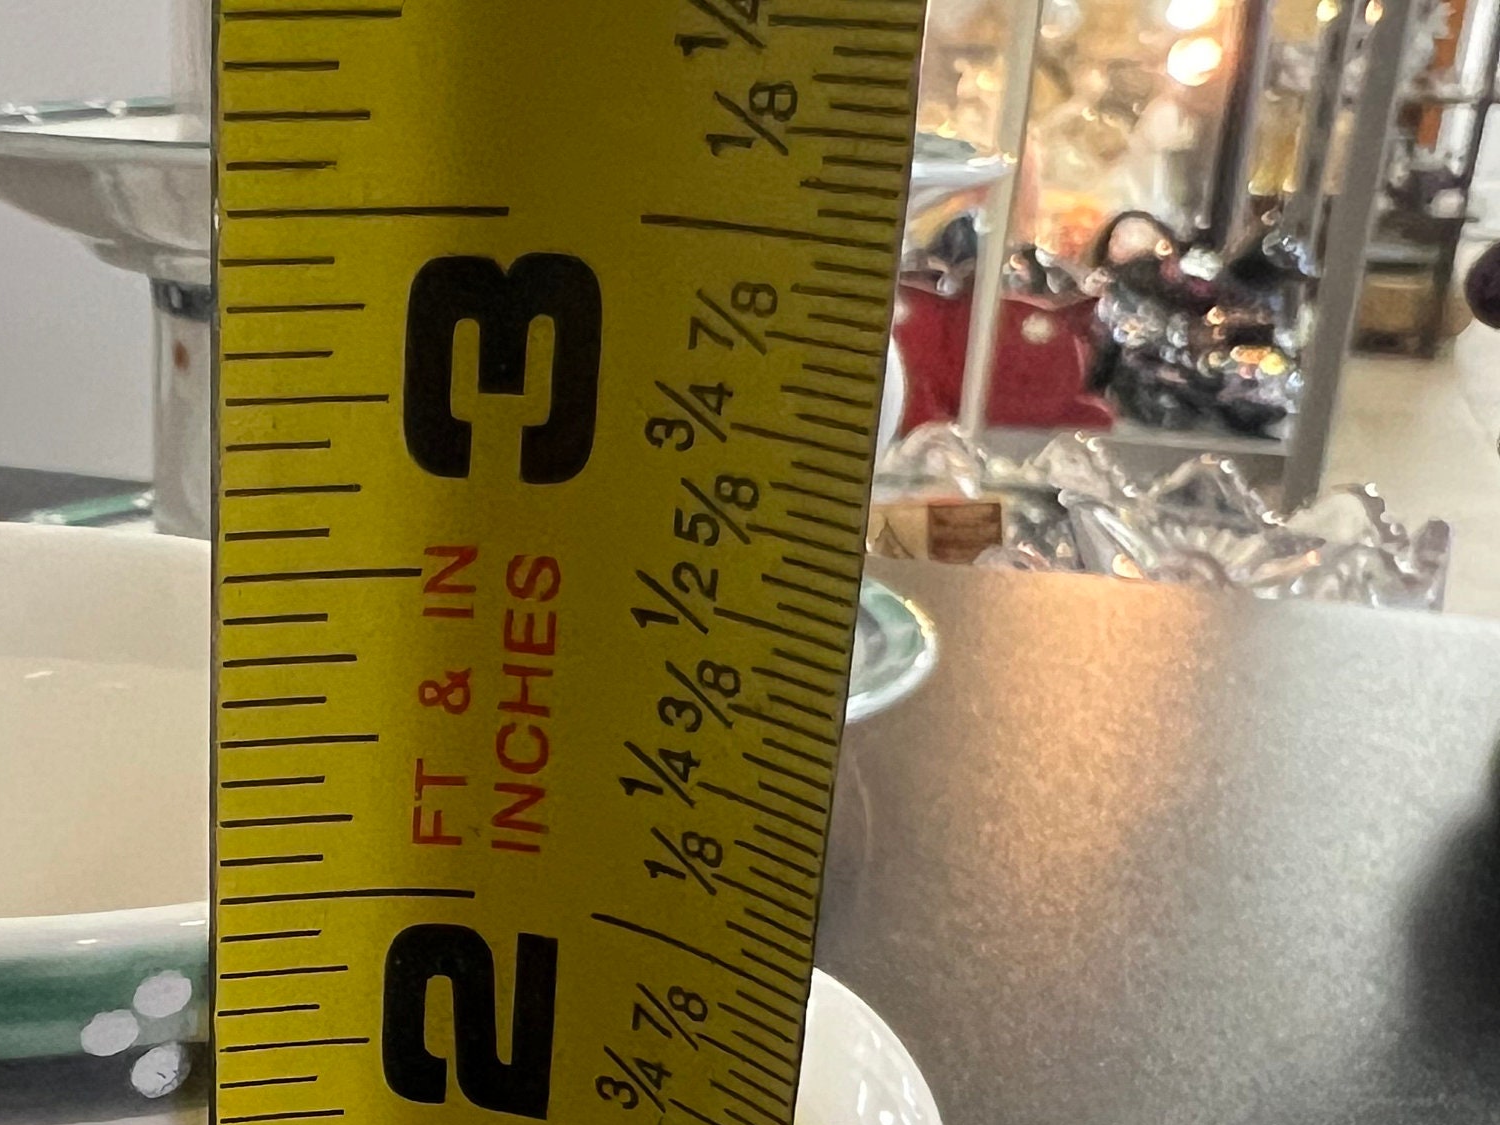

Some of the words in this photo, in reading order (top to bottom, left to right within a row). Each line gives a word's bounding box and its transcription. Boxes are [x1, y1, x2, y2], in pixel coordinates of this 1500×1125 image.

[706, 80, 798, 156] 1/8
[688, 281, 778, 355] 7/8
[403, 251, 602, 485] 3
[645, 380, 734, 452] 3/4
[674, 475, 760, 547] 5/8
[421, 543, 480, 620] IN
[630, 561, 719, 635] 1/2
[417, 667, 473, 715] &
[490, 552, 563, 855] INCHES
[657, 659, 741, 733] 3/8
[411, 756, 470, 847] FT
[619, 740, 702, 809] 1/4
[643, 826, 723, 896] 1/8
[380, 922, 559, 1121] 2
[632, 982, 708, 1051] 7/8
[595, 1045, 673, 1113] 3/4
